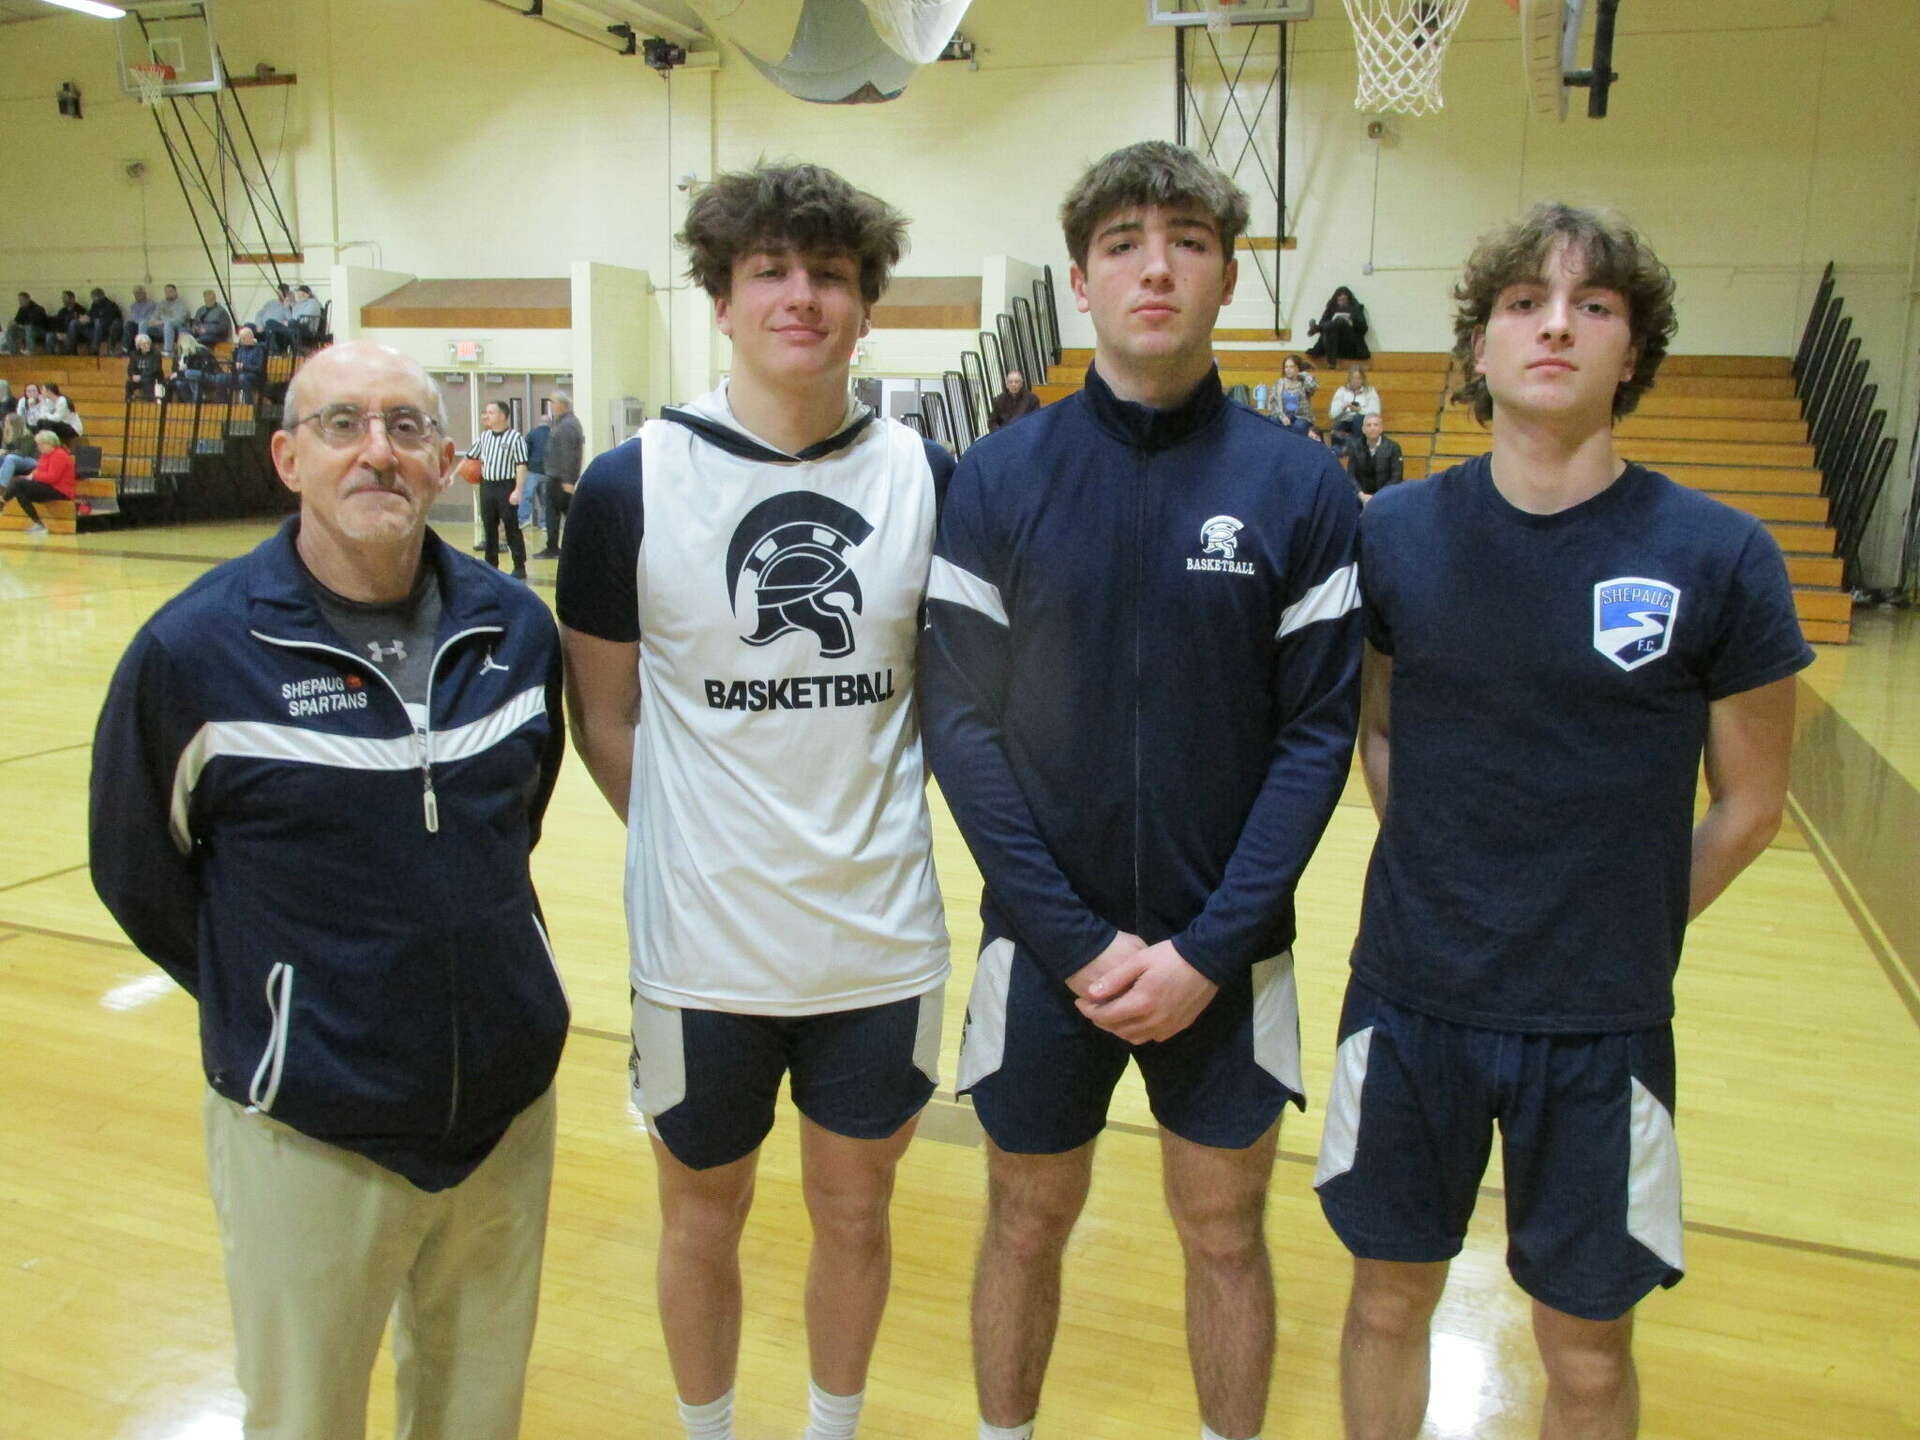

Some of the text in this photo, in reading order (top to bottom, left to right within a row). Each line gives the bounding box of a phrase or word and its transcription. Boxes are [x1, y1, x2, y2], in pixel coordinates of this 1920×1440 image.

[1186, 558, 1255, 575] BASKETBALL
[1601, 587, 1672, 609] SHEPAUG
[1637, 639, 1656, 652] F.C.
[282, 677, 345, 700] SHEPAUG
[704, 668, 896, 712] BASKETBALL
[289, 692, 368, 717] SPARTANS
